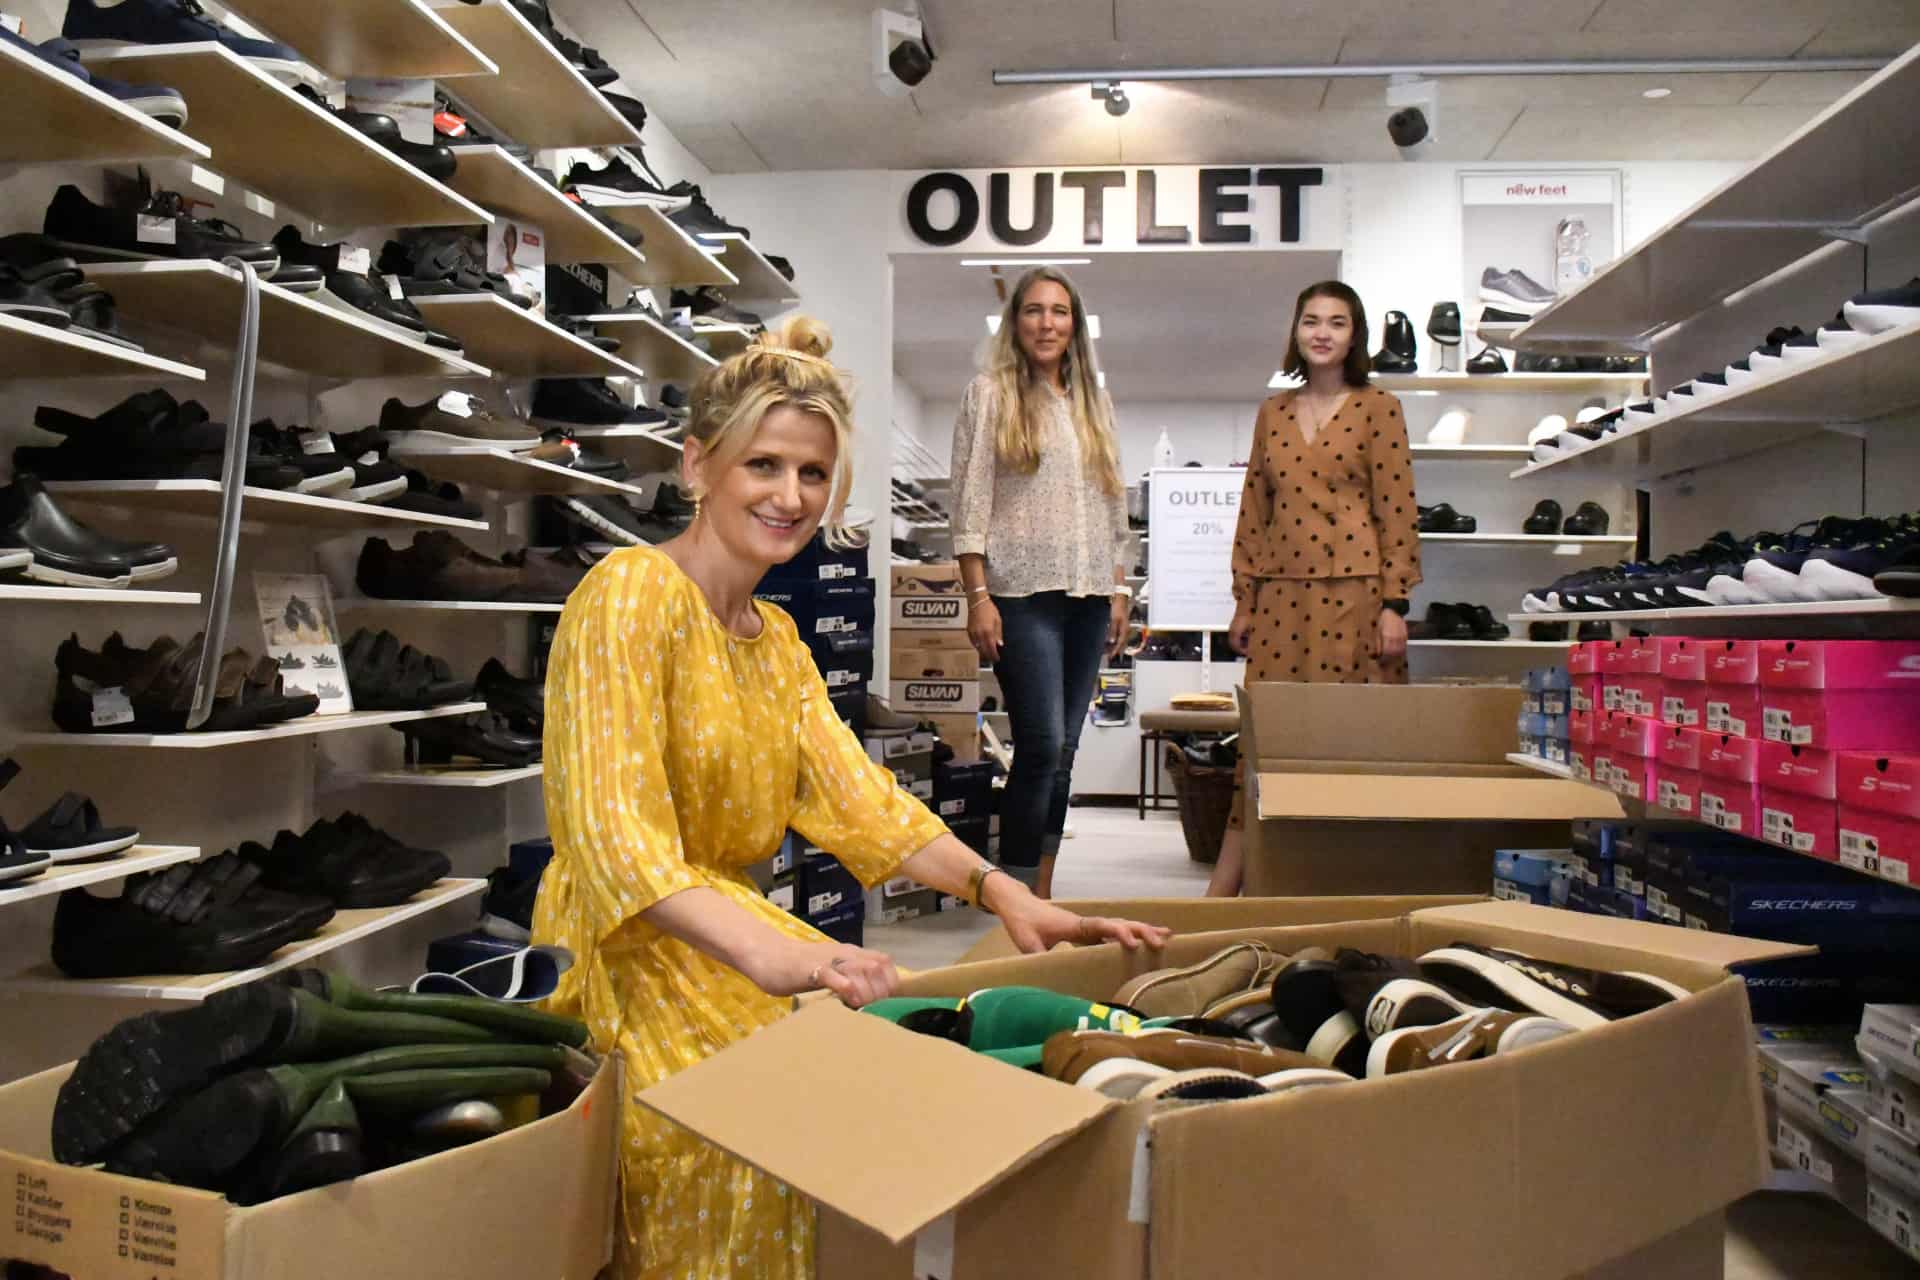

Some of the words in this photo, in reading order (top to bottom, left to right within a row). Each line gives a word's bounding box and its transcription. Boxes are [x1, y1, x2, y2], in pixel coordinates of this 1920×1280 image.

[1539, 184, 1567, 195] feet
[907, 168, 1324, 246] OUTLET
[1192, 522, 1224, 536] 20%
[904, 602, 958, 615] SILVAN
[908, 685, 961, 699] SILVAN
[1748, 899, 1857, 911] SKECHERS
